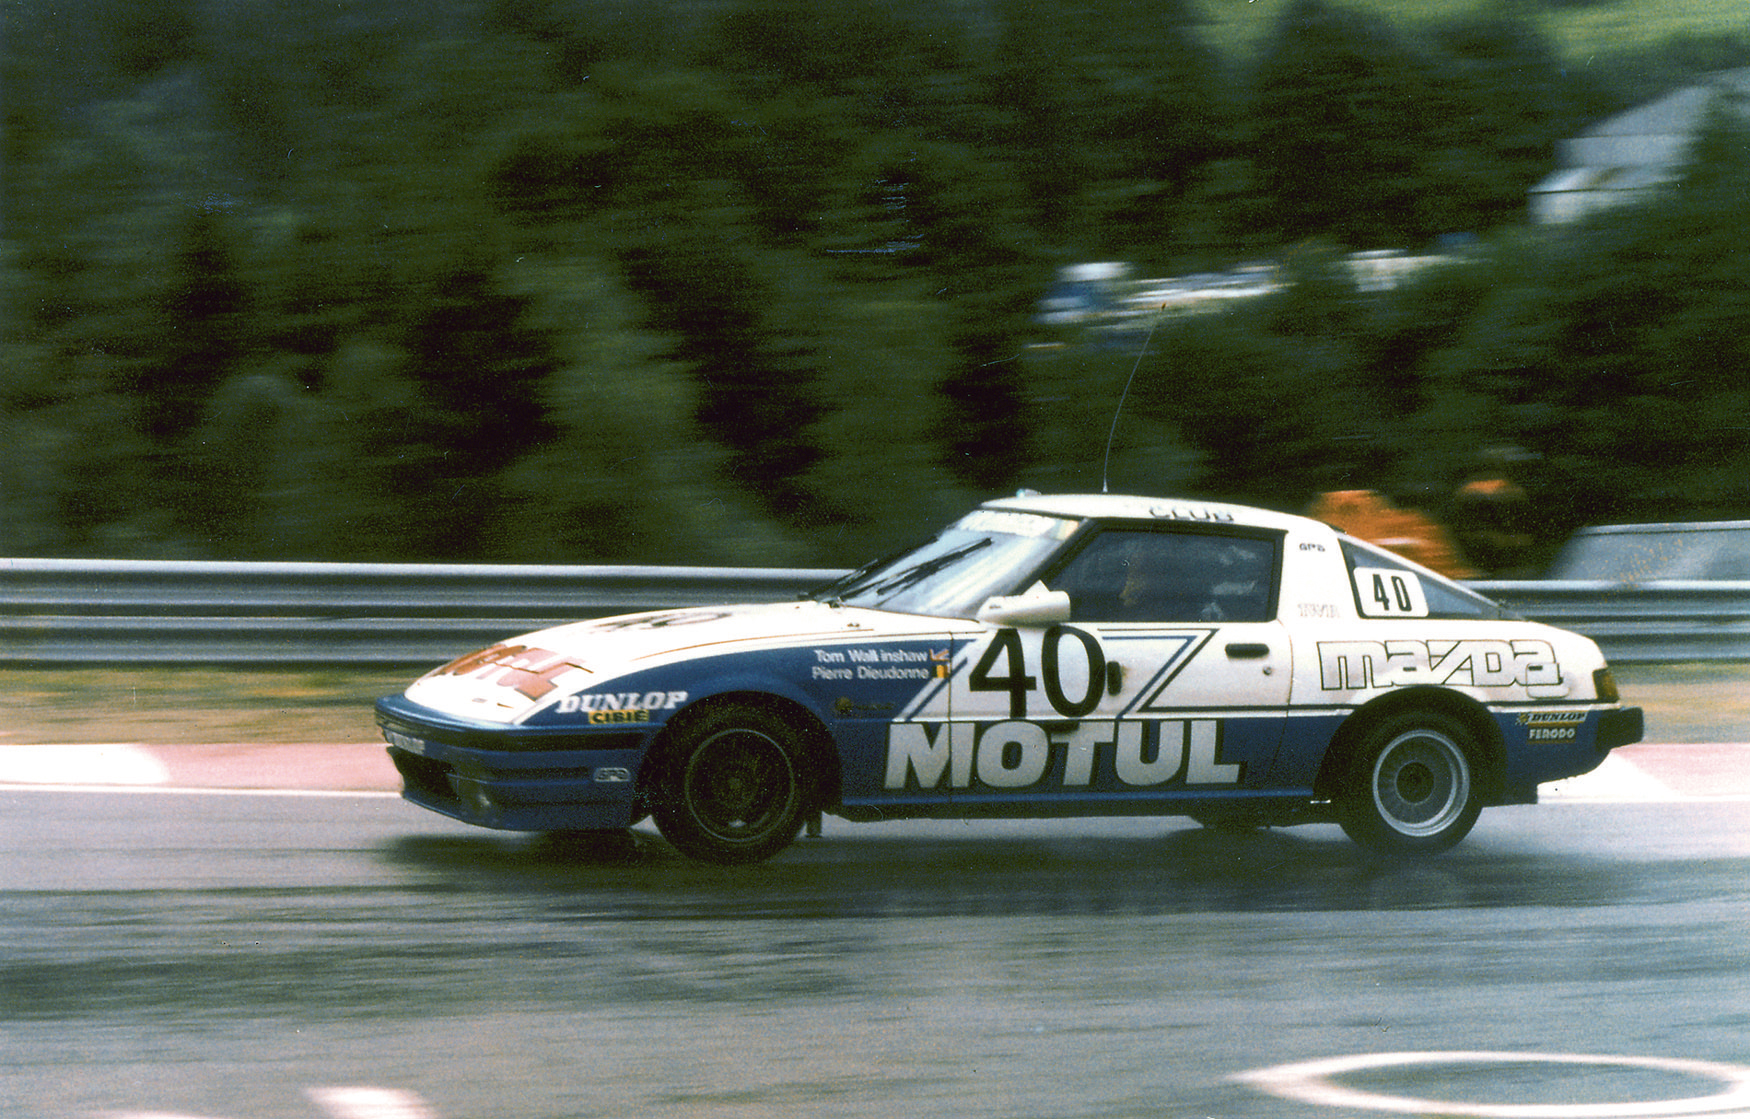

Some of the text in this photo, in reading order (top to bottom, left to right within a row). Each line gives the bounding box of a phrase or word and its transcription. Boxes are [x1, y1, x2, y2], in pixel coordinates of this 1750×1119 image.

[1372, 573, 1413, 612] 40
[814, 649, 845, 663] Tom
[812, 666, 853, 679] Pierre
[968, 625, 1106, 719] 40
[555, 691, 688, 713] DUNLOP
[592, 710, 650, 723] CIBIE
[1528, 711, 1587, 722] DUNLOP
[1528, 728, 1576, 739] FERODO
[884, 719, 1241, 789] MOTUL
